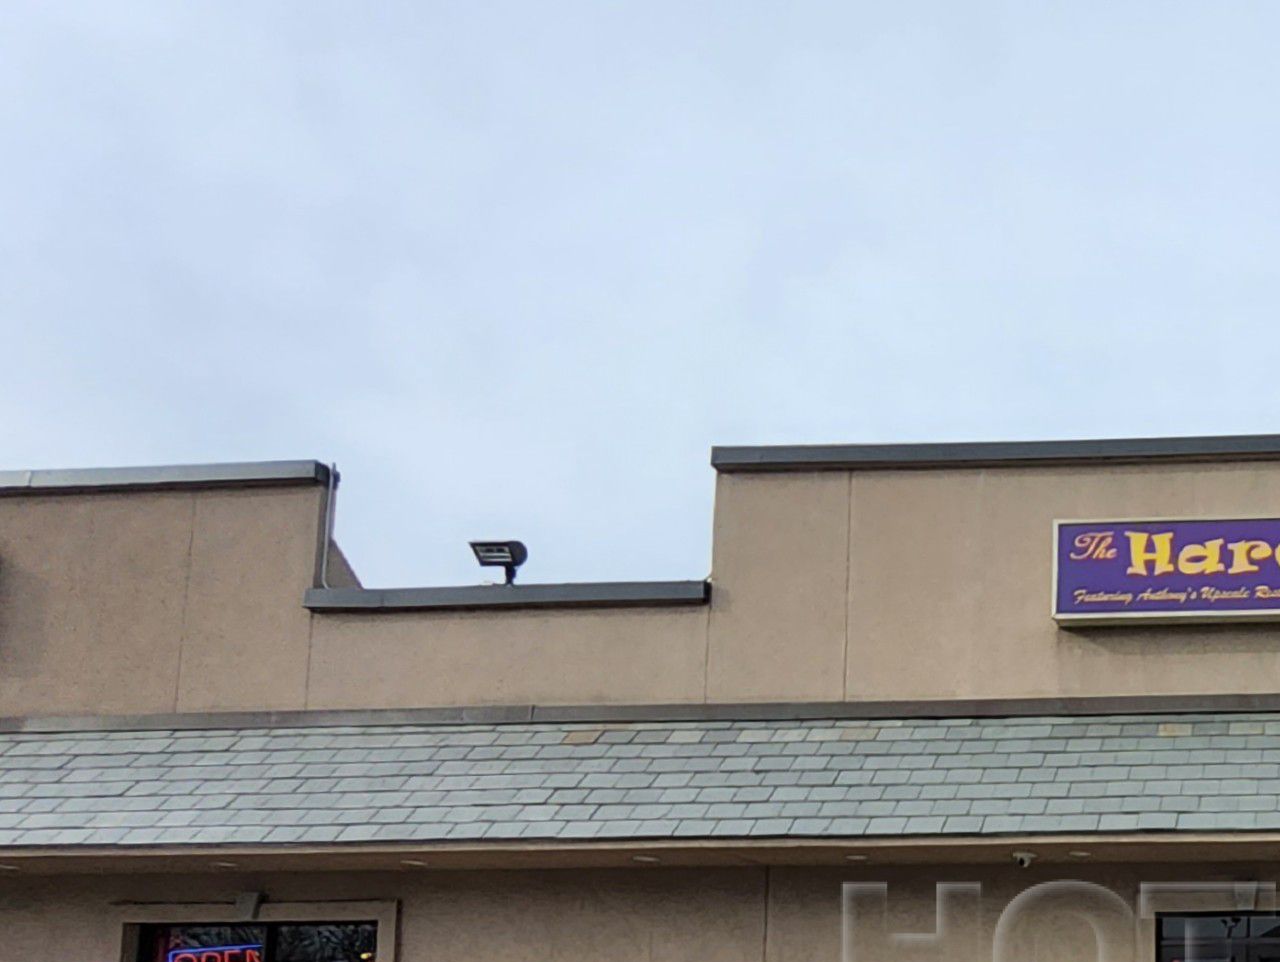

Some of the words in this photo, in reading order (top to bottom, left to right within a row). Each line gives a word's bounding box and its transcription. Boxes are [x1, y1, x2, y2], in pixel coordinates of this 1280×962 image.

[1069, 530, 1117, 561] The
[1073, 588, 1134, 606] Featuring
[1135, 586, 1198, 604] Anthony's
[1199, 585, 1250, 604] Upscale
